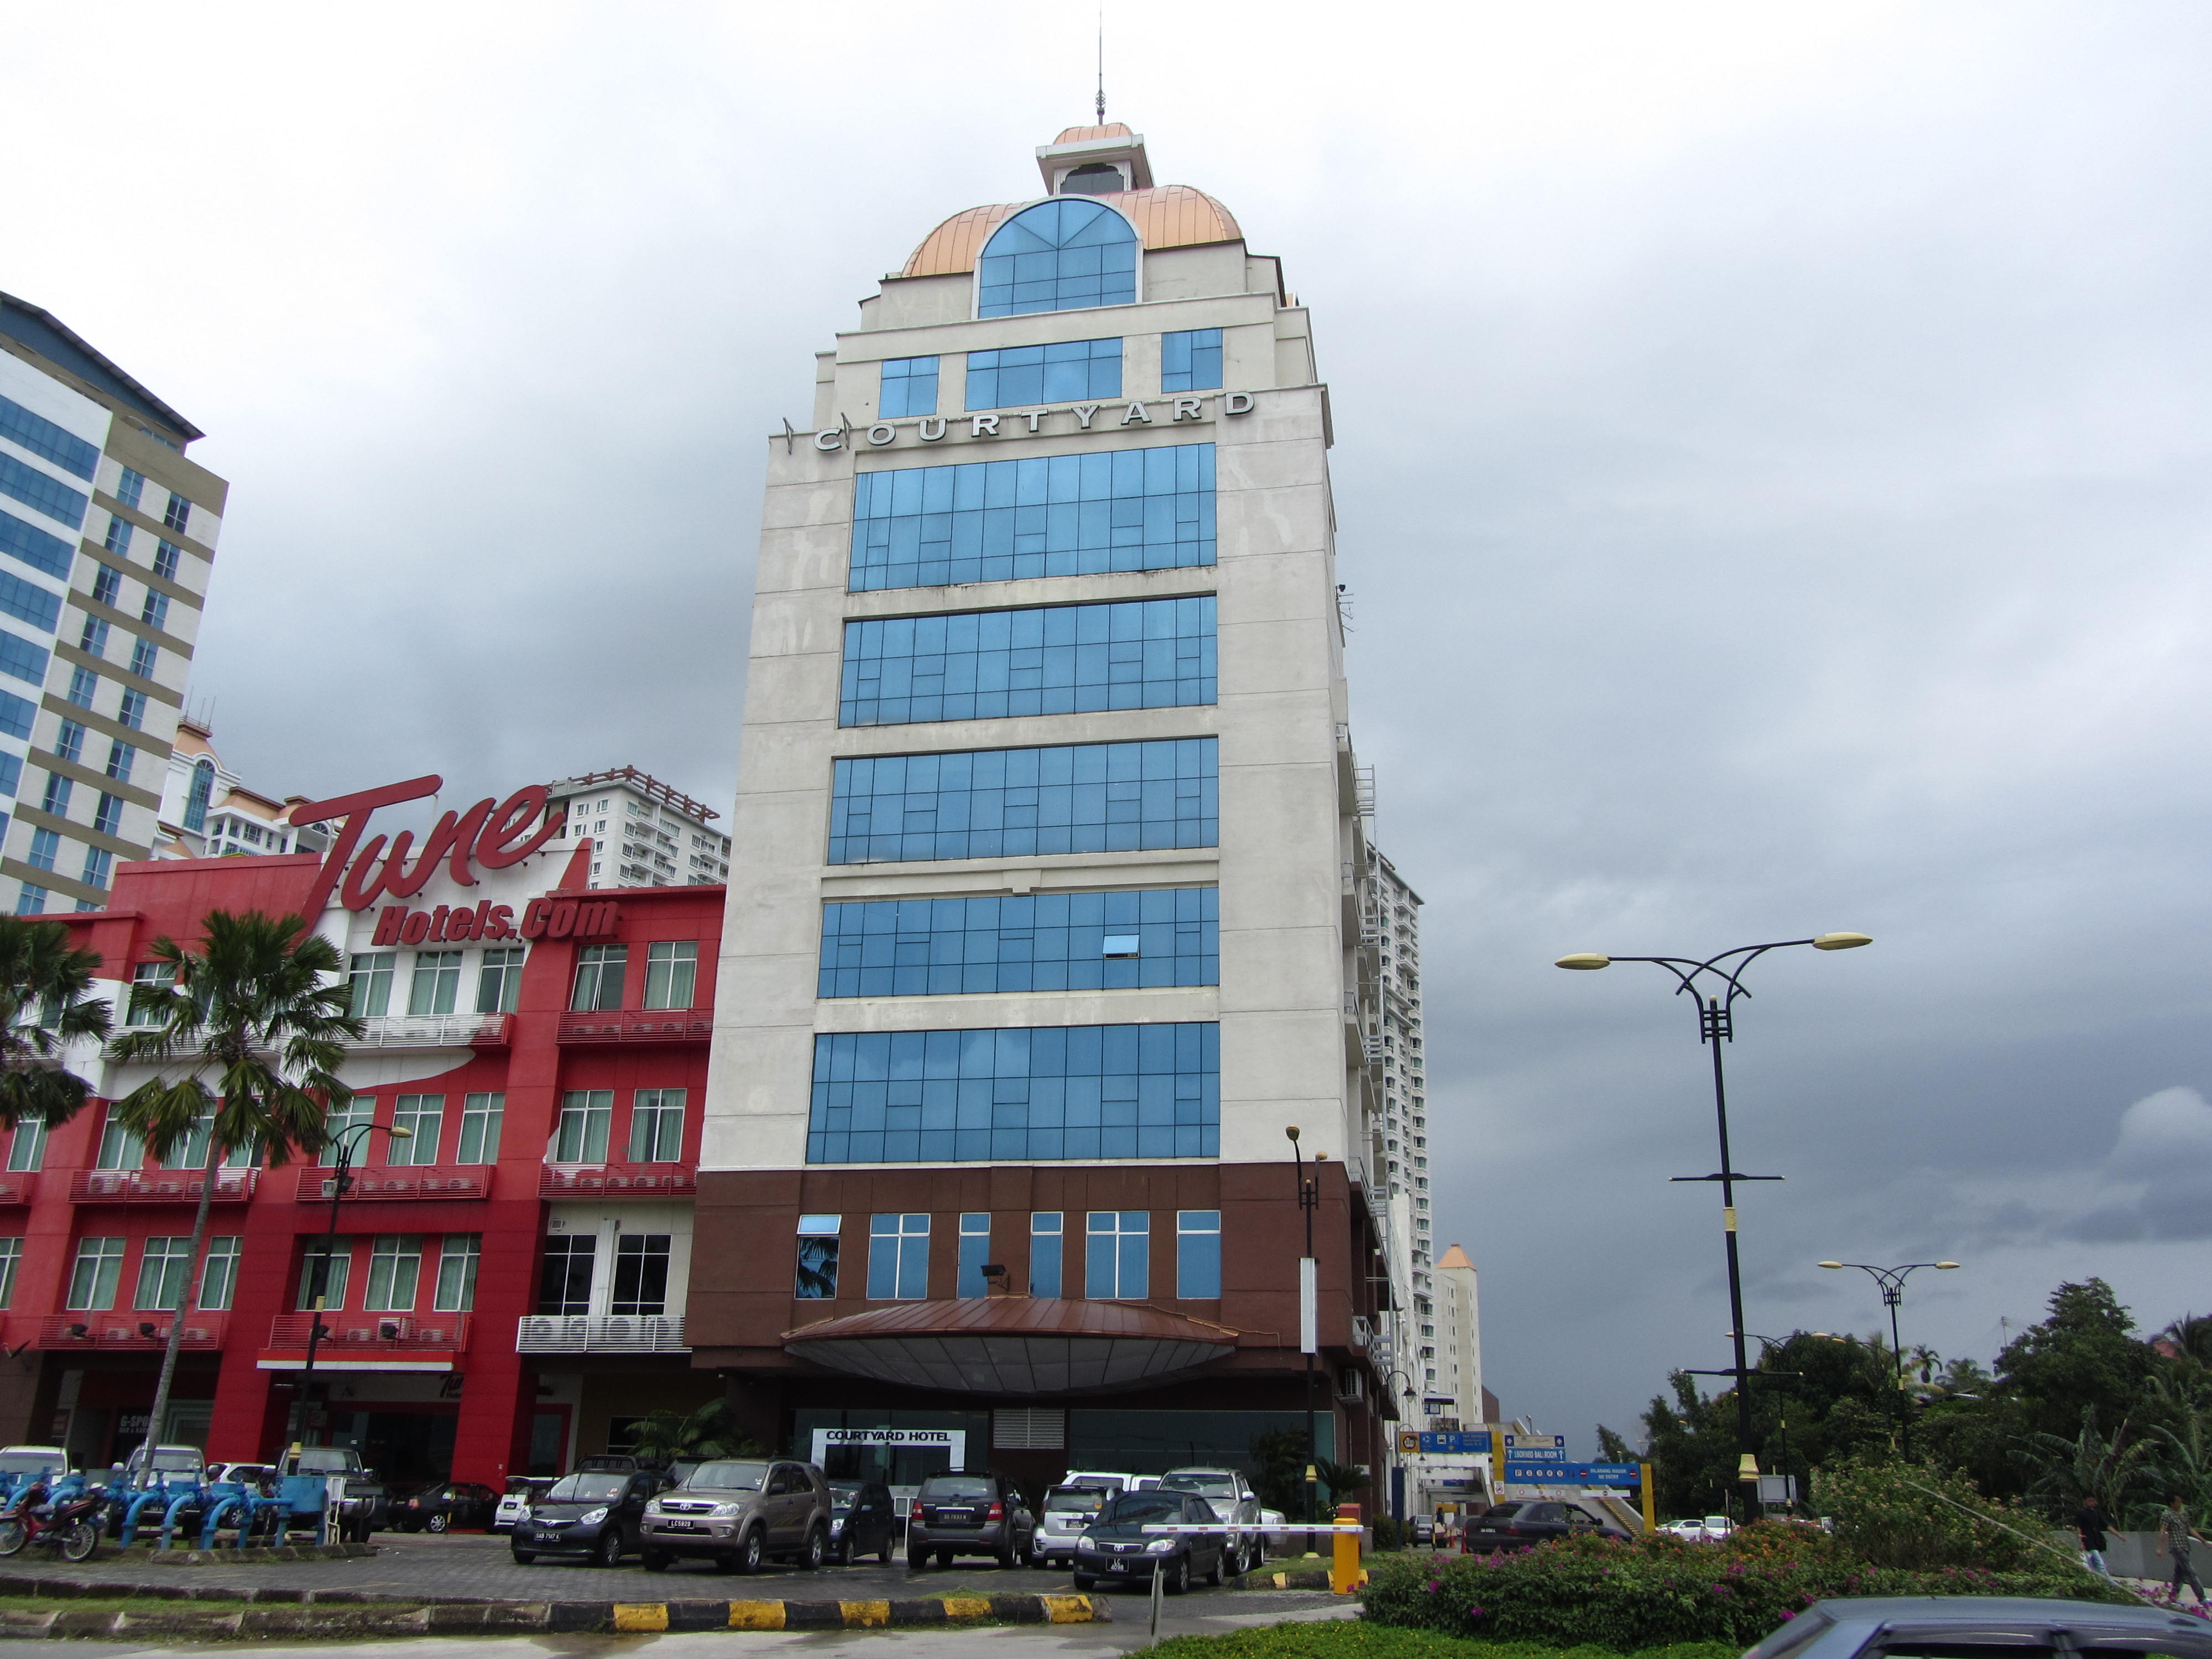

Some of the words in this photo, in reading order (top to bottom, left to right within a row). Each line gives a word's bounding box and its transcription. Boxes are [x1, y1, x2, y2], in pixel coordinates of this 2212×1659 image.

[813, 391, 1255, 452] COURTYARD
[289, 774, 566, 956] Tune
[371, 897, 620, 946] Hotels.Com
[120, 1415, 149, 1427] G-SPO
[826, 1430, 905, 1441] COURTYARD
[909, 1431, 952, 1441] HOTEL
